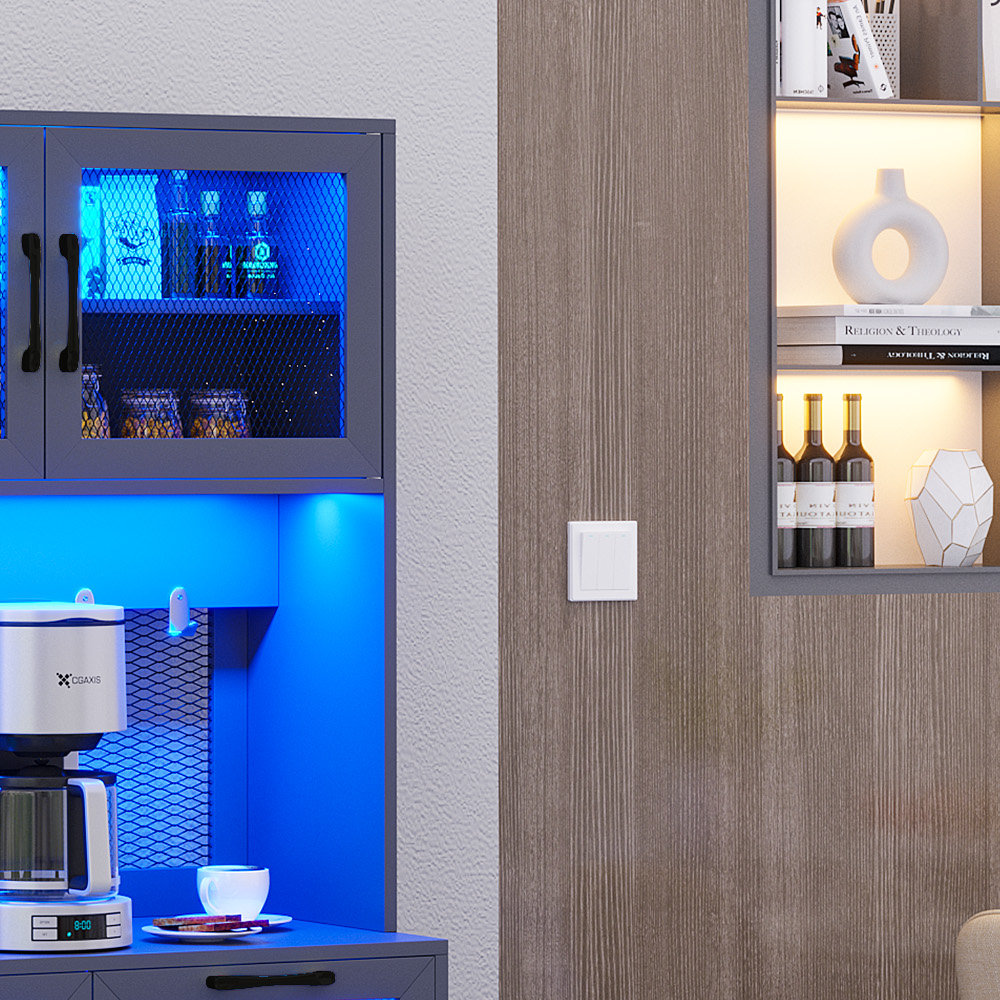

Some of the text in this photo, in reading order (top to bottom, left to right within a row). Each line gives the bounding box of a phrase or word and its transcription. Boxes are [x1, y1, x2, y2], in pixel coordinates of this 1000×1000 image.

[845, 325, 962, 337] RELIGION & THEOLOGY
[936, 352, 946, 360] &
[71, 675, 101, 685] CGAXIS
[74, 919, 92, 931] 8:00
